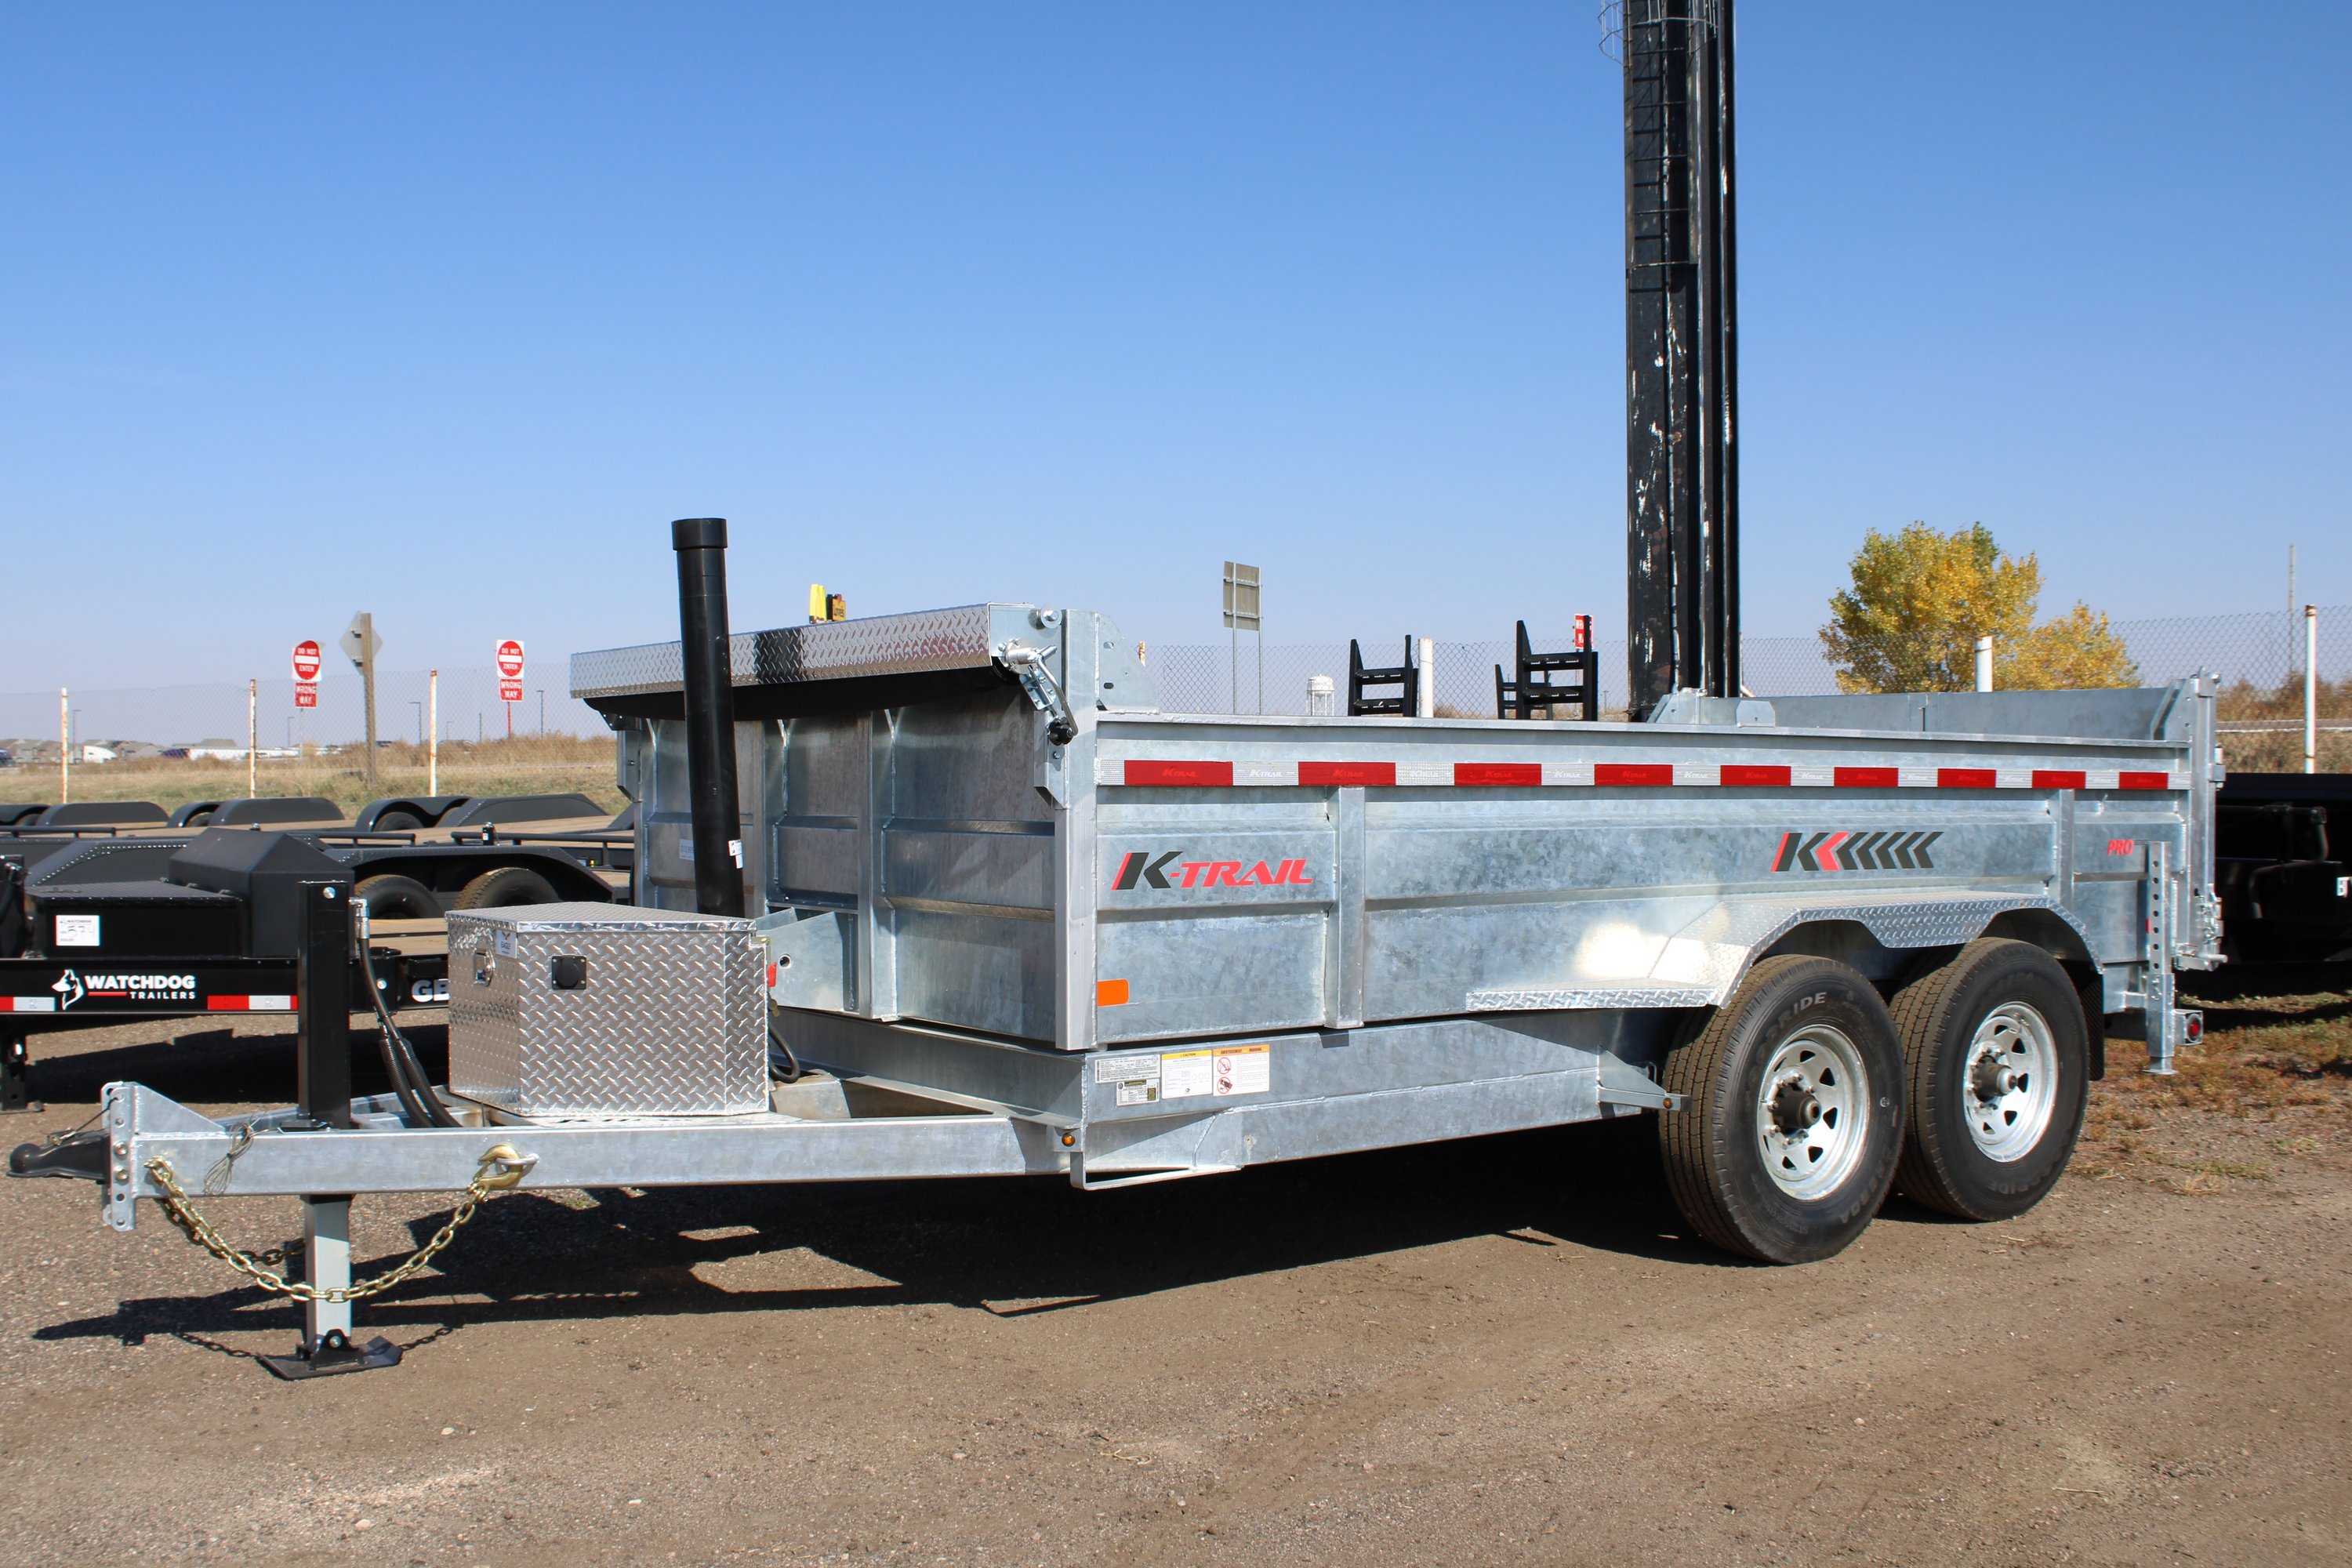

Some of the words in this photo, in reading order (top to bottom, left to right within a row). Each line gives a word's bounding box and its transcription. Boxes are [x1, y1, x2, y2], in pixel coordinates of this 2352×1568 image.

[296, 686, 317, 695] WRONG
[2107, 839, 2134, 855] PRO
[1111, 851, 1313, 891] K-TRAIL
[84, 975, 195, 989] WATCHDOG
